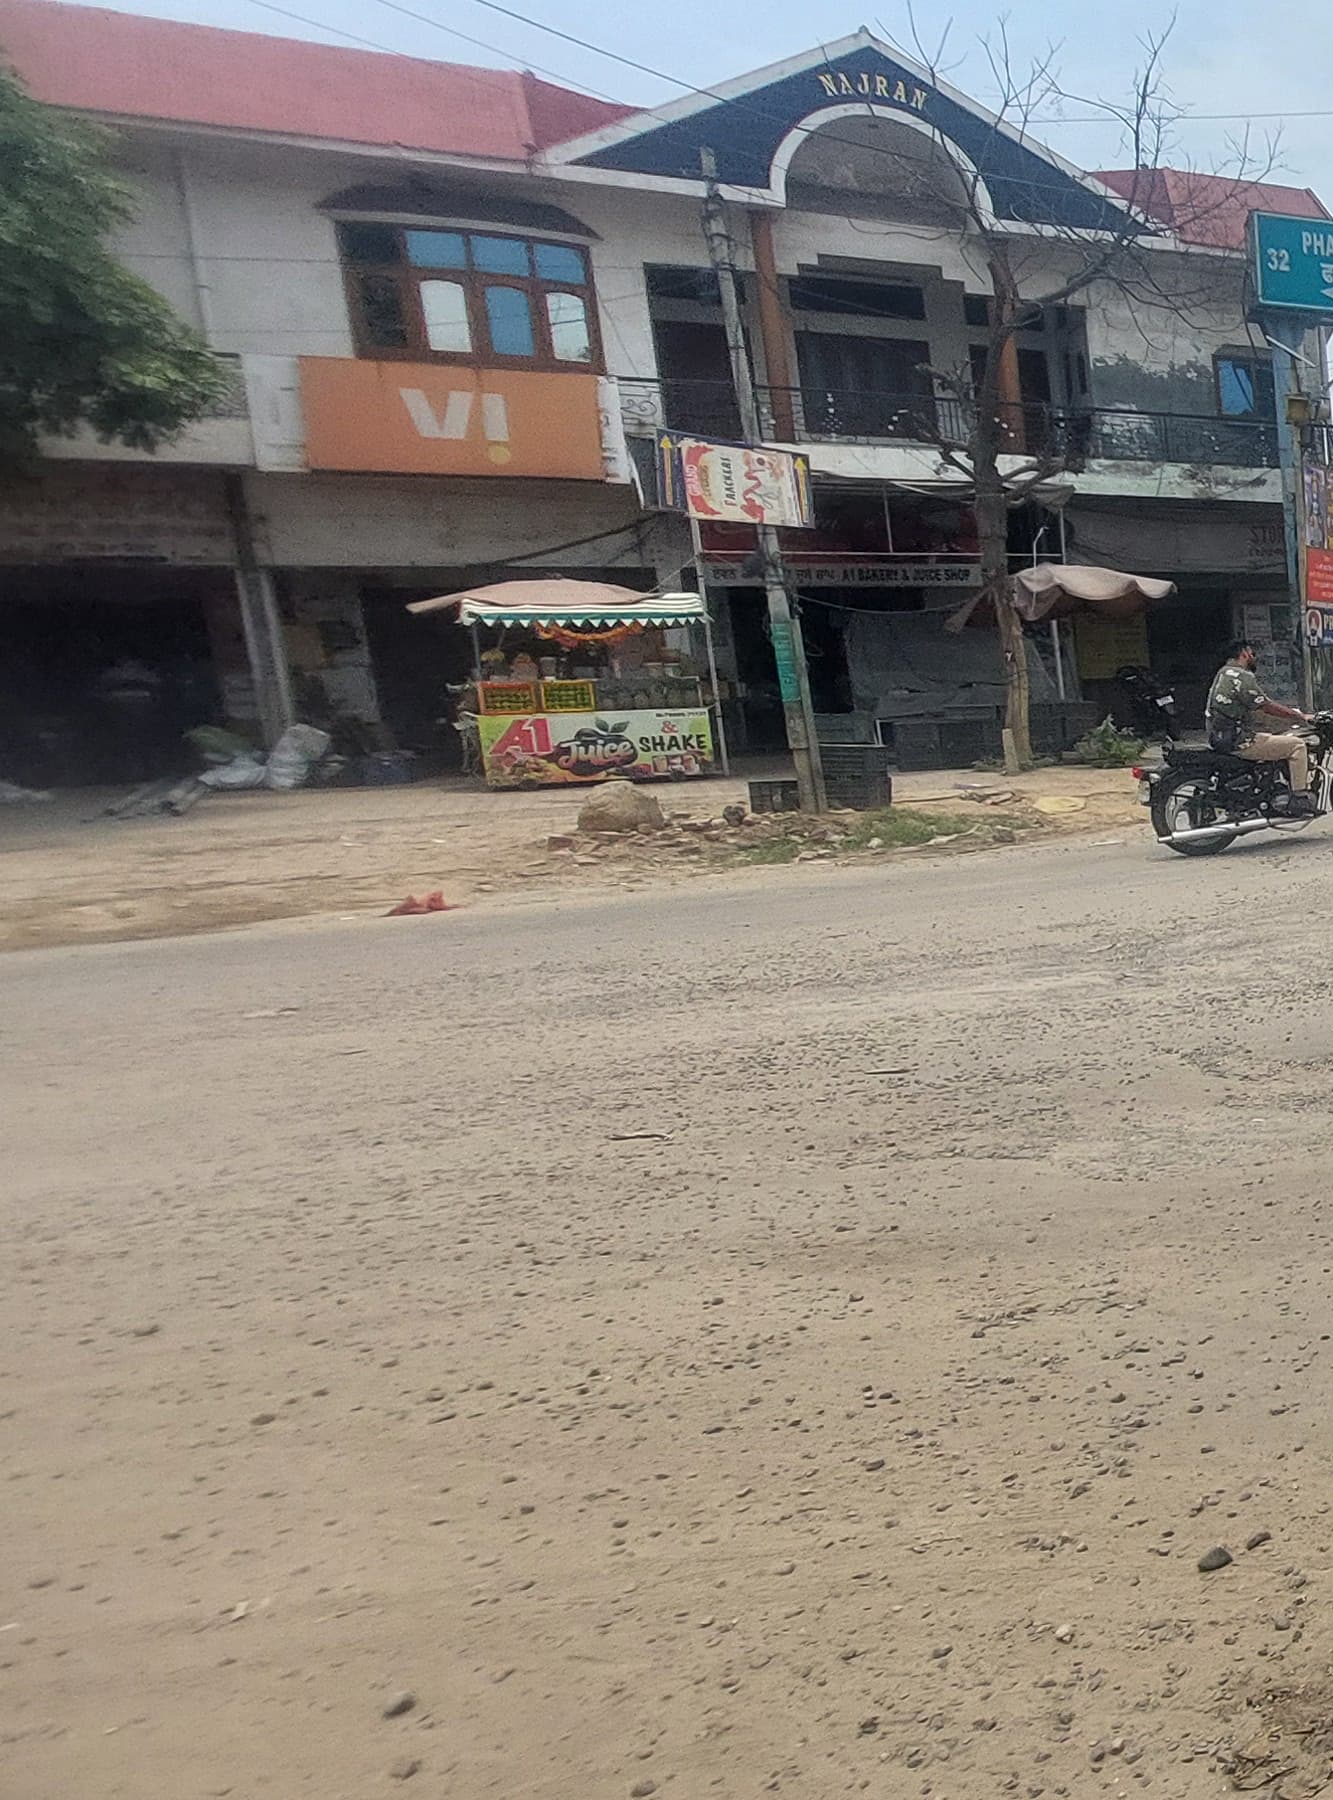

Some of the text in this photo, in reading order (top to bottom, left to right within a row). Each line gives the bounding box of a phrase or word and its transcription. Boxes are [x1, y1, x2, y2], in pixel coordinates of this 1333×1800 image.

[817, 72, 927, 110] NAJRAN
[1267, 248, 1290, 272] 32
[858, 568, 898, 582] BAKERY
[944, 568, 970, 582] SHOP
[489, 717, 552, 755] A1
[661, 720, 678, 734] &
[558, 740, 634, 769] Juice
[639, 734, 707, 752] SHAKE
